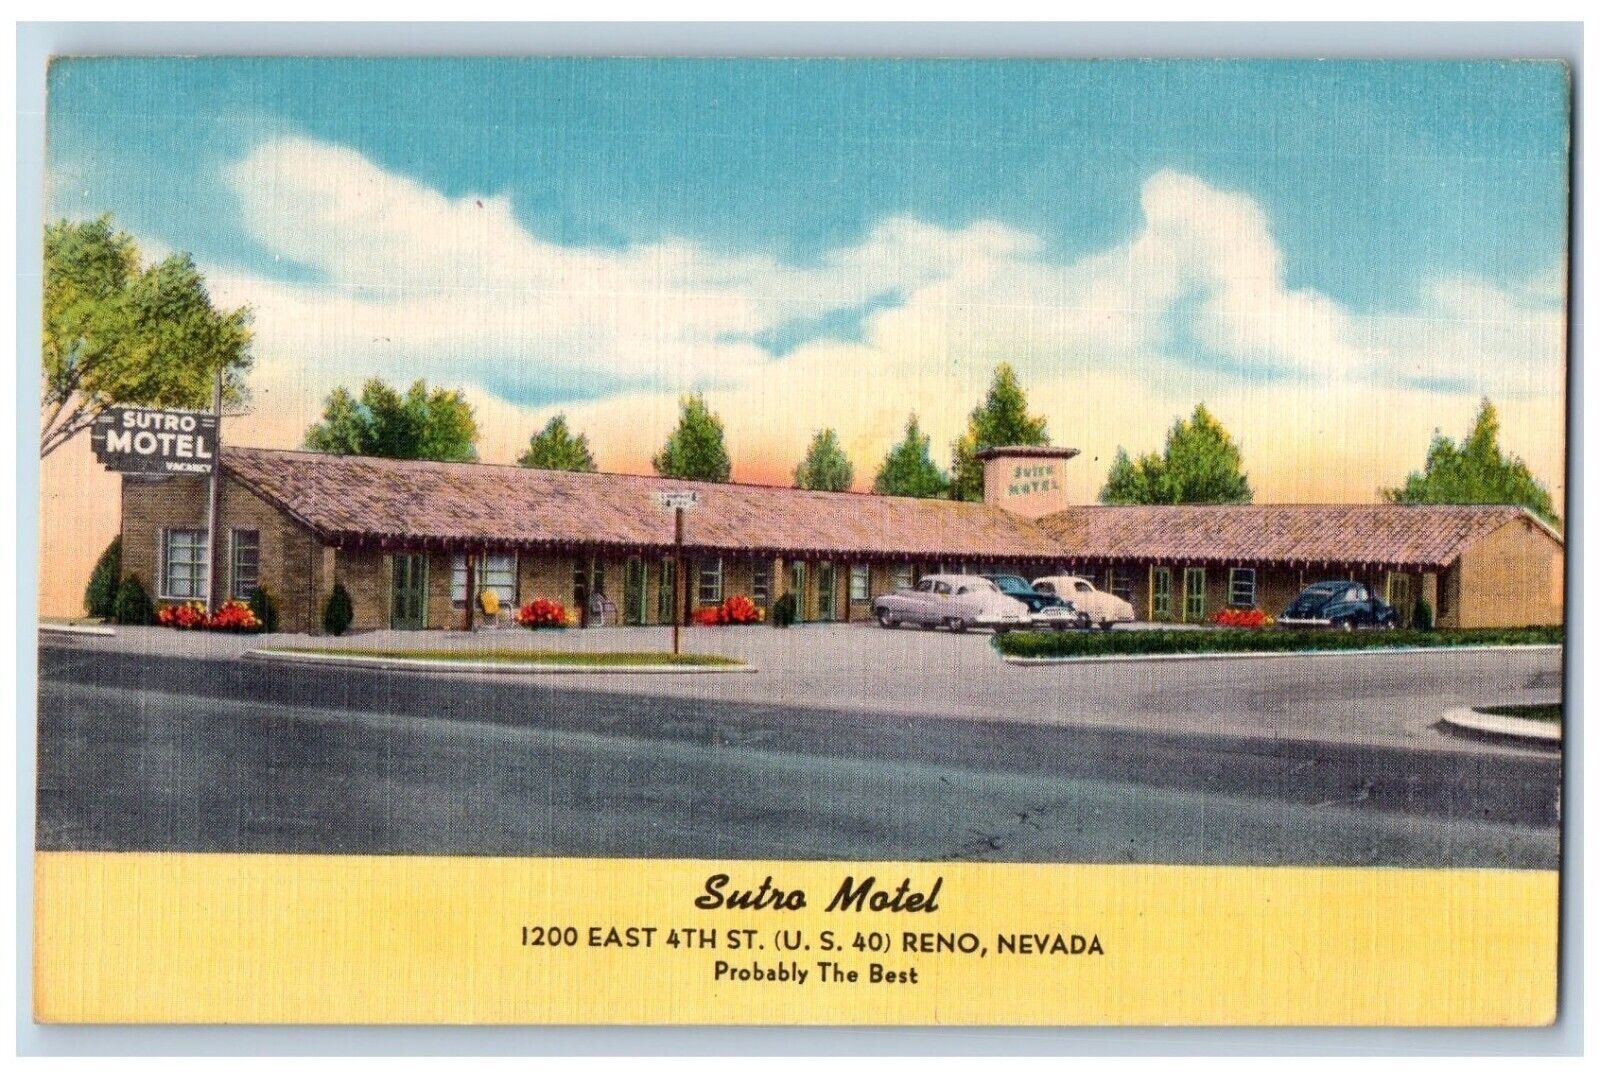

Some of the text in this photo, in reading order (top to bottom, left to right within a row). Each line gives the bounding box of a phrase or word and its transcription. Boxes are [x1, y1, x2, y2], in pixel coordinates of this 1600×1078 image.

[122, 410, 196, 432] SUTRO
[106, 429, 213, 459] MOTEL
[694, 873, 943, 913] Sutro Motel
[522, 926, 1104, 958] 1200 EAST 4TH ST. (U. S. 40) RENO, NEVADA
[714, 960, 918, 985] Probably The Best
